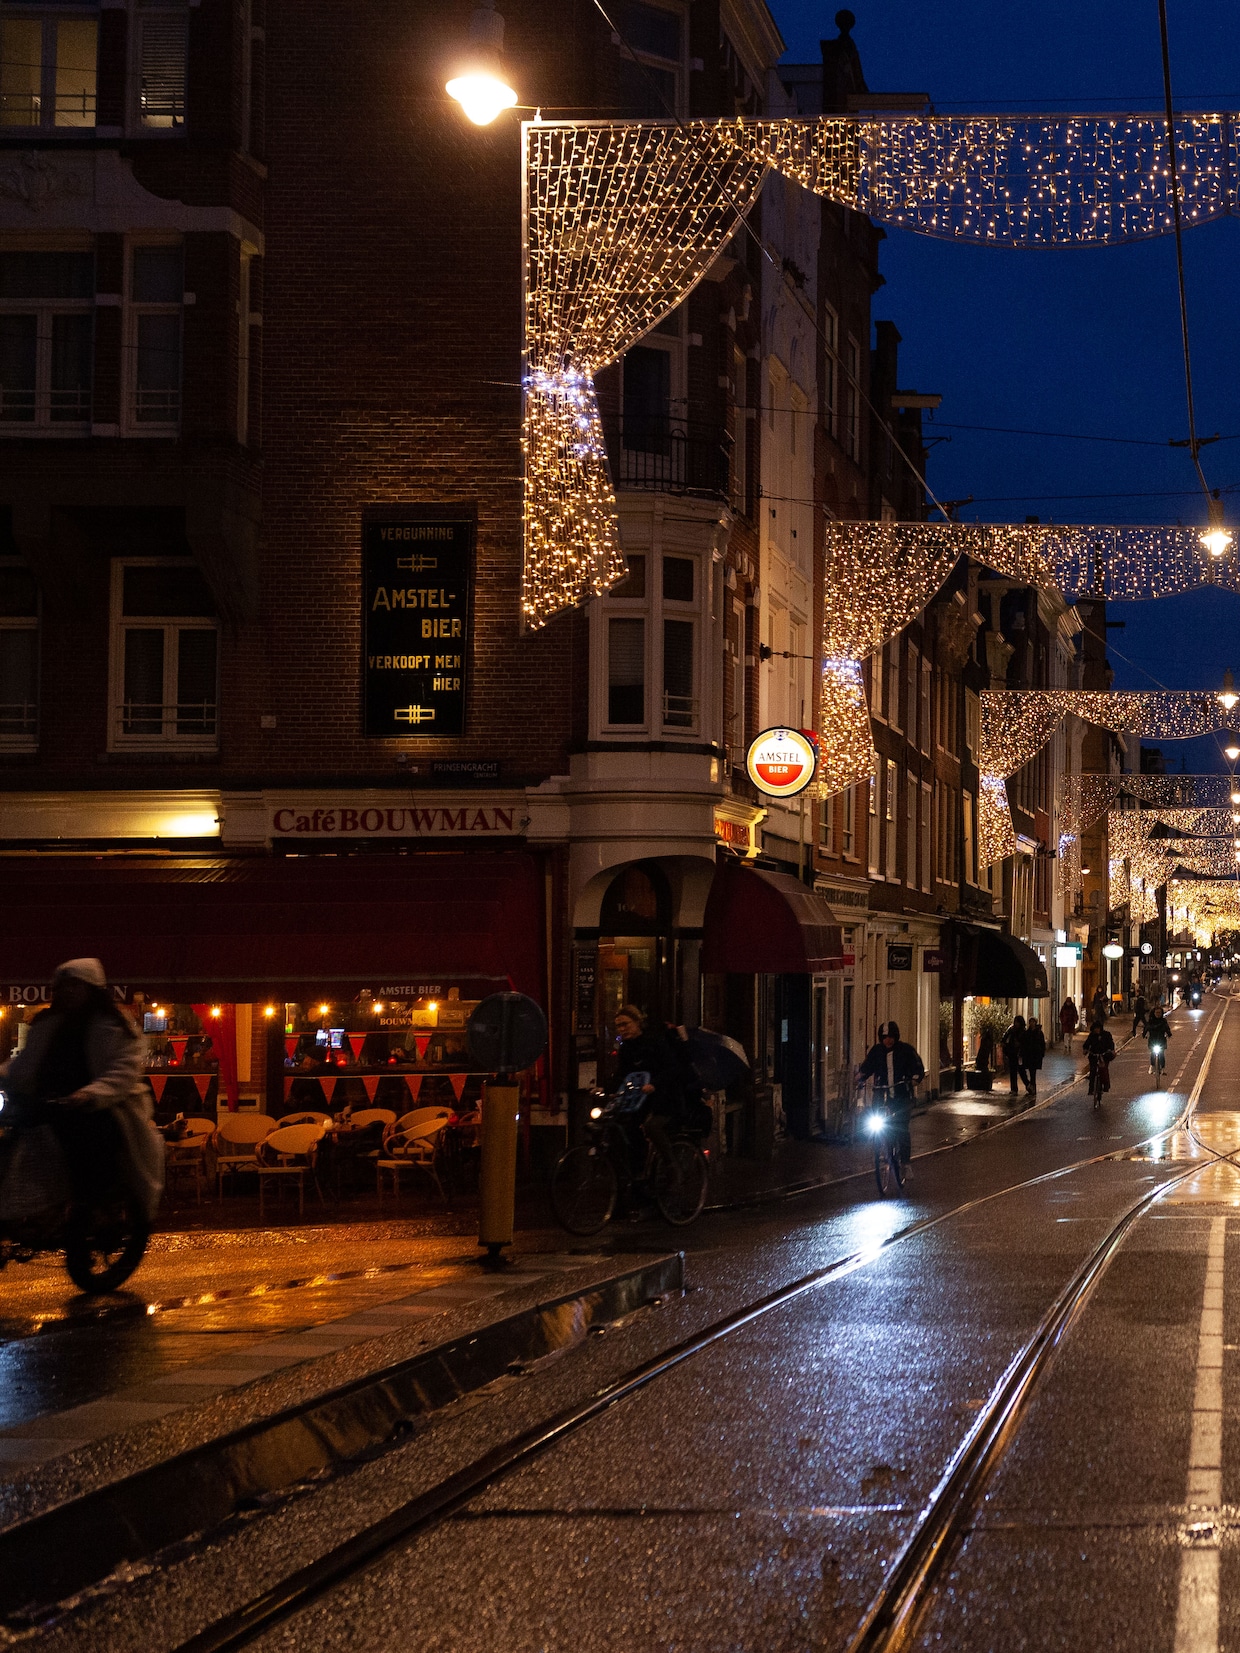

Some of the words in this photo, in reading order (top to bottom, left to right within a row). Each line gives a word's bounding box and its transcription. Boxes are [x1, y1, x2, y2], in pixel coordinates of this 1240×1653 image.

[380, 527, 454, 541] VERGUNNING
[421, 618, 462, 639] BIER
[368, 655, 431, 669] VERKOOPT
[435, 655, 461, 669] MEN
[433, 677, 461, 691] HIER
[758, 752, 800, 762] AMSTEL
[433, 762, 498, 772] PRINSENGRACHT
[768, 765, 789, 774] BIER
[273, 808, 336, 832] Café
[338, 808, 516, 832] BOUWMAN
[379, 985, 416, 995] AMSTEL
[418, 985, 442, 995] BIER
